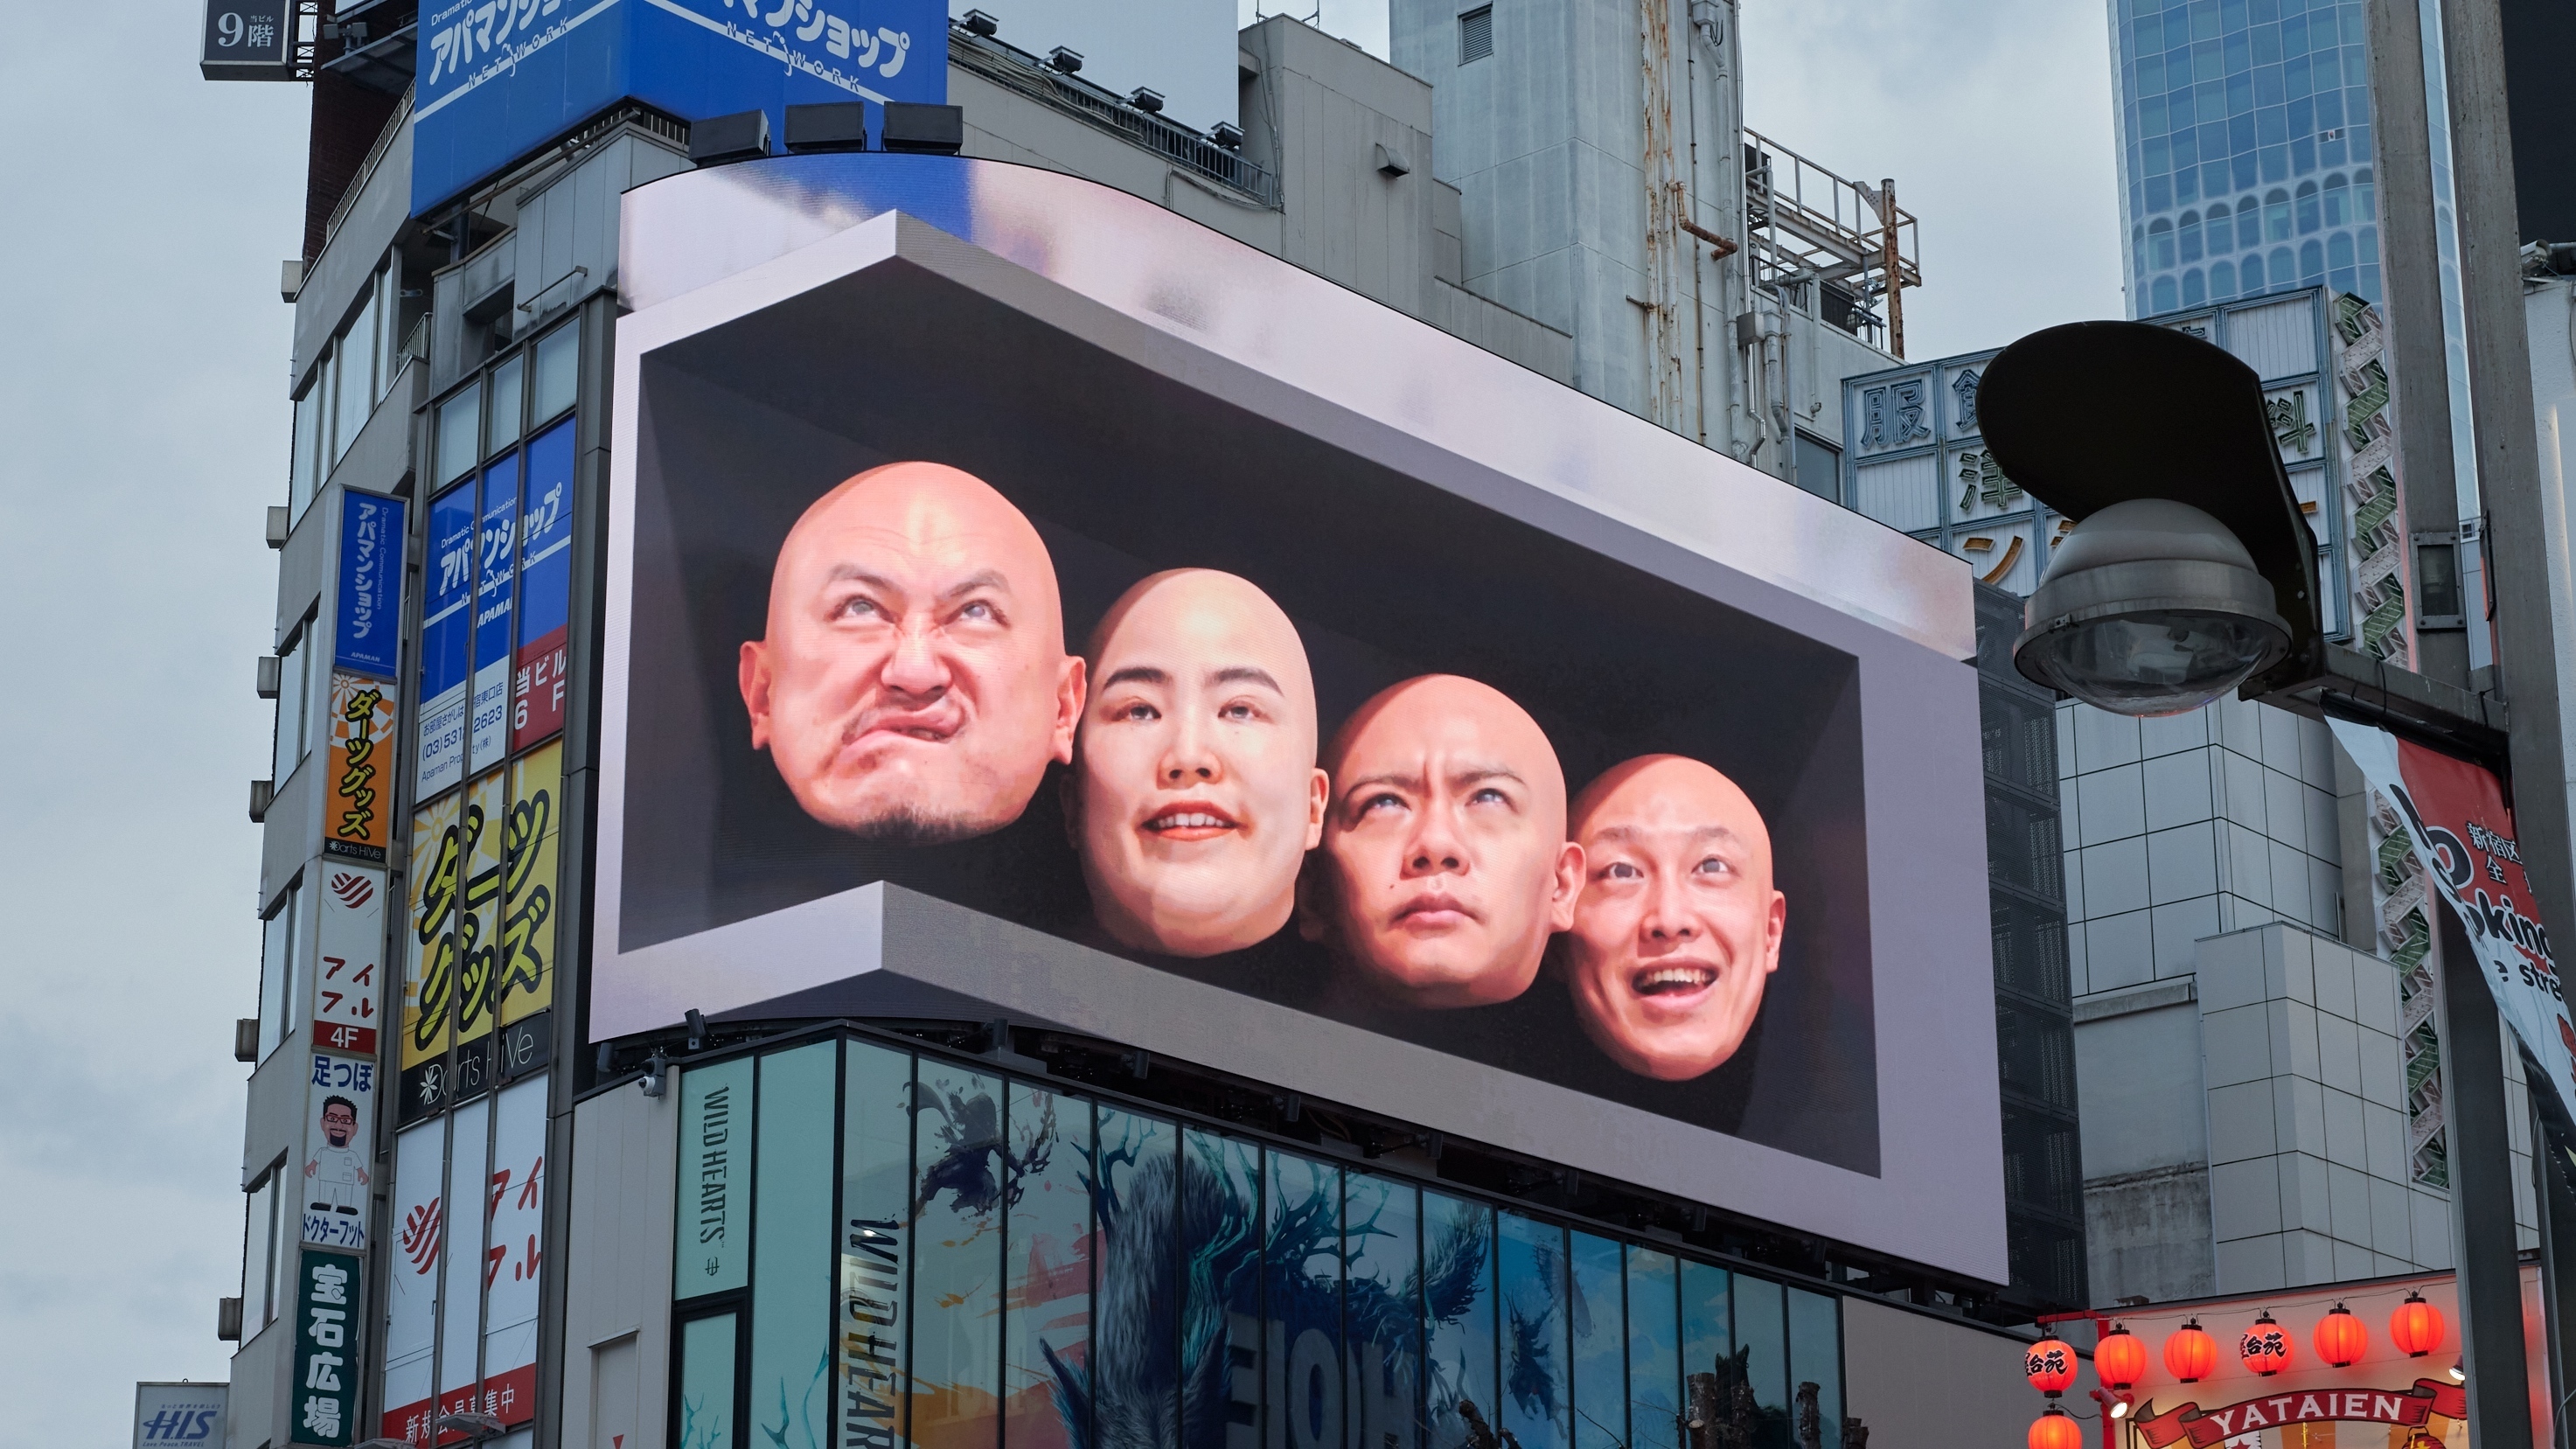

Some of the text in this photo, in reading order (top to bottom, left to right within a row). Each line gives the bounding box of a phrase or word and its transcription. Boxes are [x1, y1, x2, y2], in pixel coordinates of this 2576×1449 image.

[352, 502, 378, 638] アパマンショップ
[376, 548, 386, 610] Communication
[351, 651, 380, 662] APAMAN
[516, 649, 567, 697] 当ビル
[338, 689, 383, 840] ダーツグッズ
[2466, 822, 2524, 865] 新宿区
[2486, 854, 2508, 884] 全
[331, 1027, 359, 1048] 4F
[311, 1055, 373, 1092] 足つぼ
[700, 1084, 729, 1243] WILD HEARTS
[303, 1213, 365, 1249] ドクターフット
[848, 1219, 900, 1328] WILD
[303, 1264, 348, 1439] 宝石広場
[2210, 1392, 2403, 1436] YATAIEN
